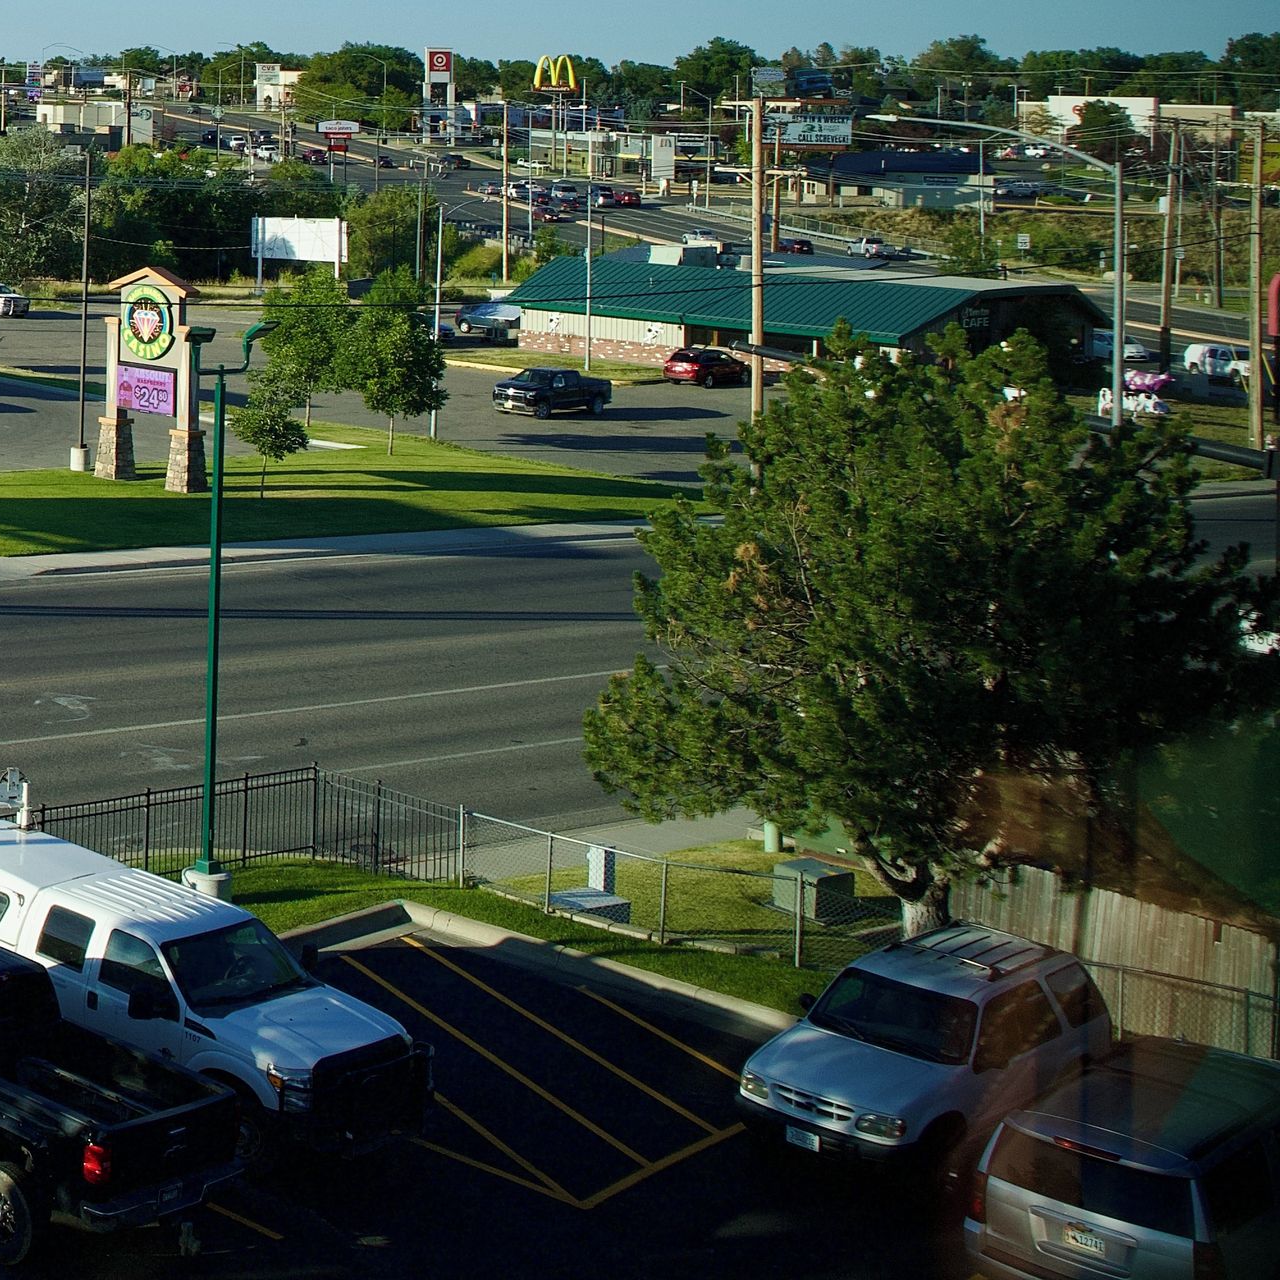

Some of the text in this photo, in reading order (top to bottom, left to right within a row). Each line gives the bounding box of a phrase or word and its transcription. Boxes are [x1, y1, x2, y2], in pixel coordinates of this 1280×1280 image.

[963, 317, 990, 328] CAFE
[122, 328, 171, 359] CASINO
[185, 1031, 201, 1044] 1107
